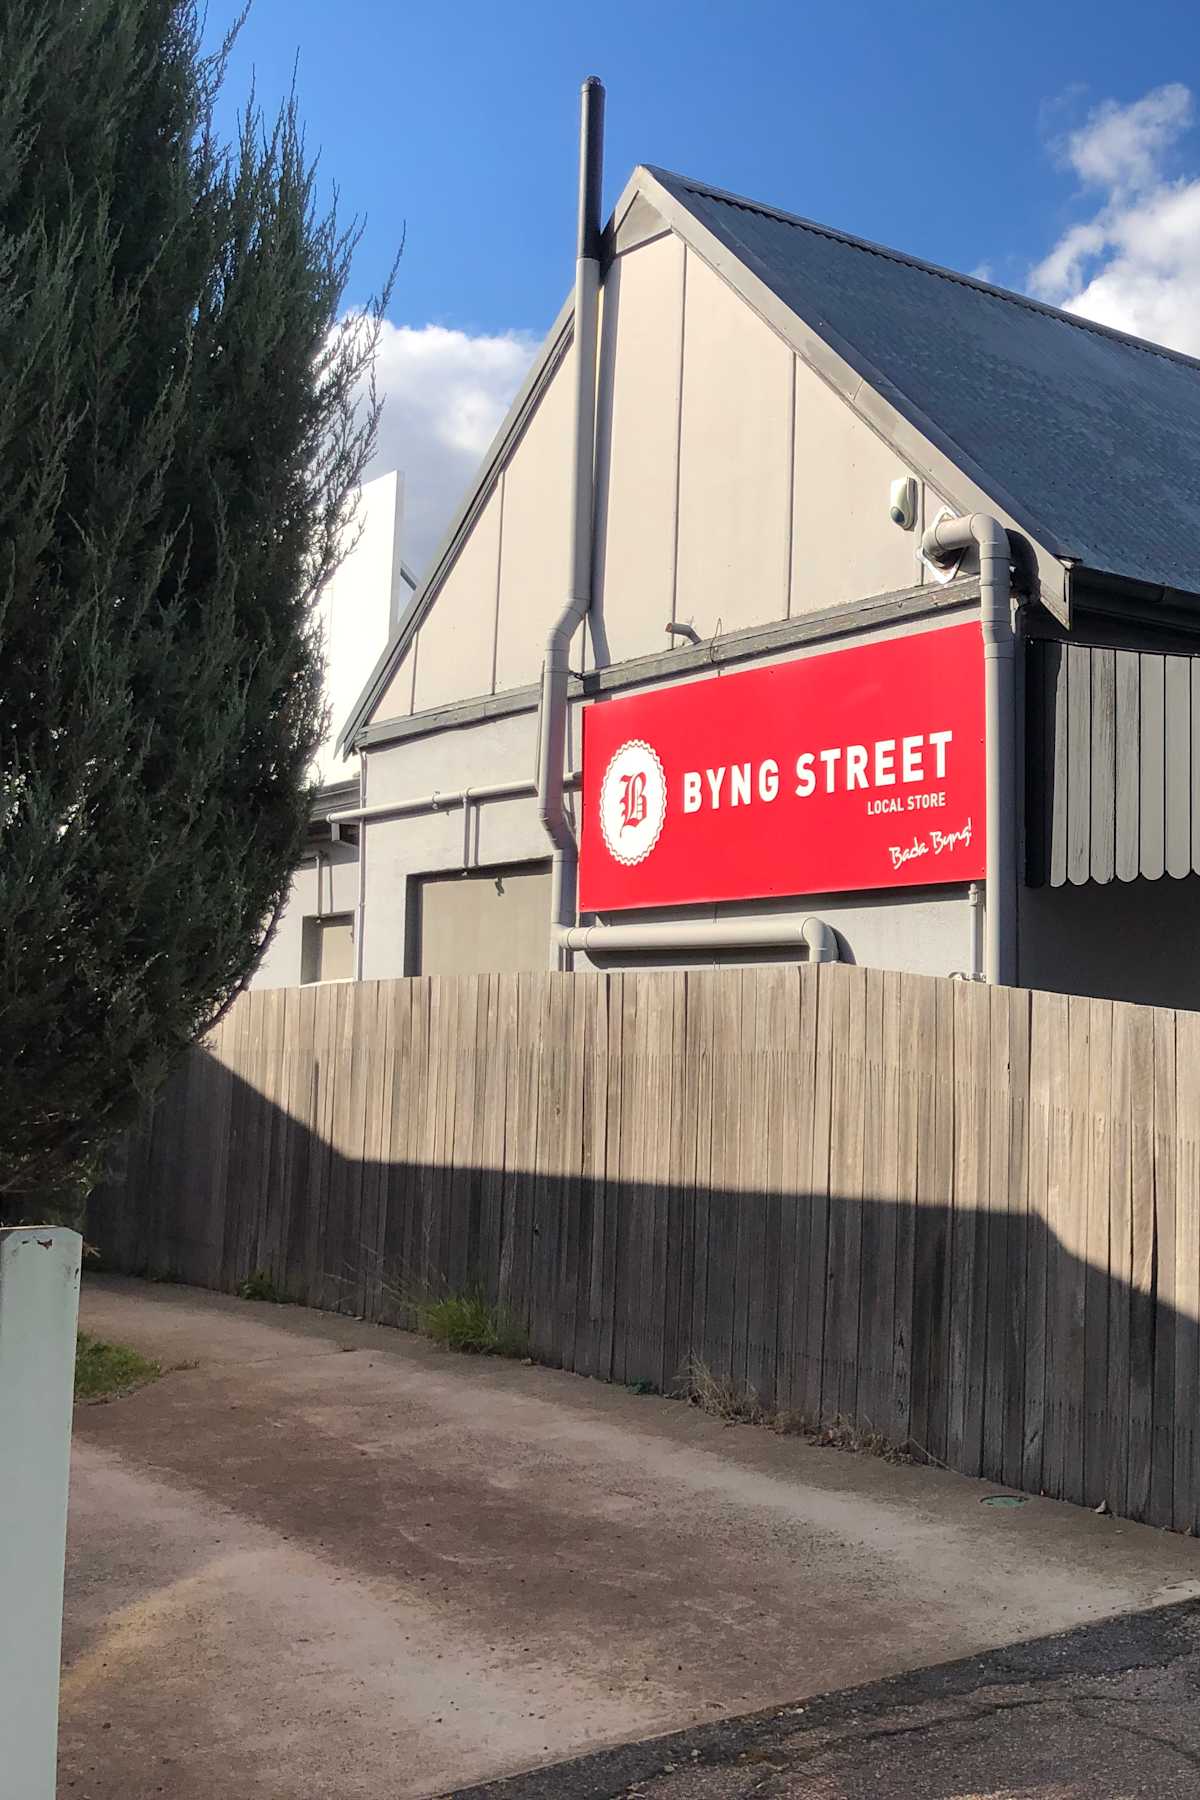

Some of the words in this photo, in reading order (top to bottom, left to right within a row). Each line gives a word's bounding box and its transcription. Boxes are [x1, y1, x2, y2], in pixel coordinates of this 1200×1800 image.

[683, 759, 779, 814] BYNG
[795, 730, 953, 797] STREET
[619, 771, 647, 838] B
[867, 798, 904, 815] LOCAL
[907, 791, 946, 811] STORE
[888, 836, 929, 870] Bada
[929, 817, 972, 855] Byng!
